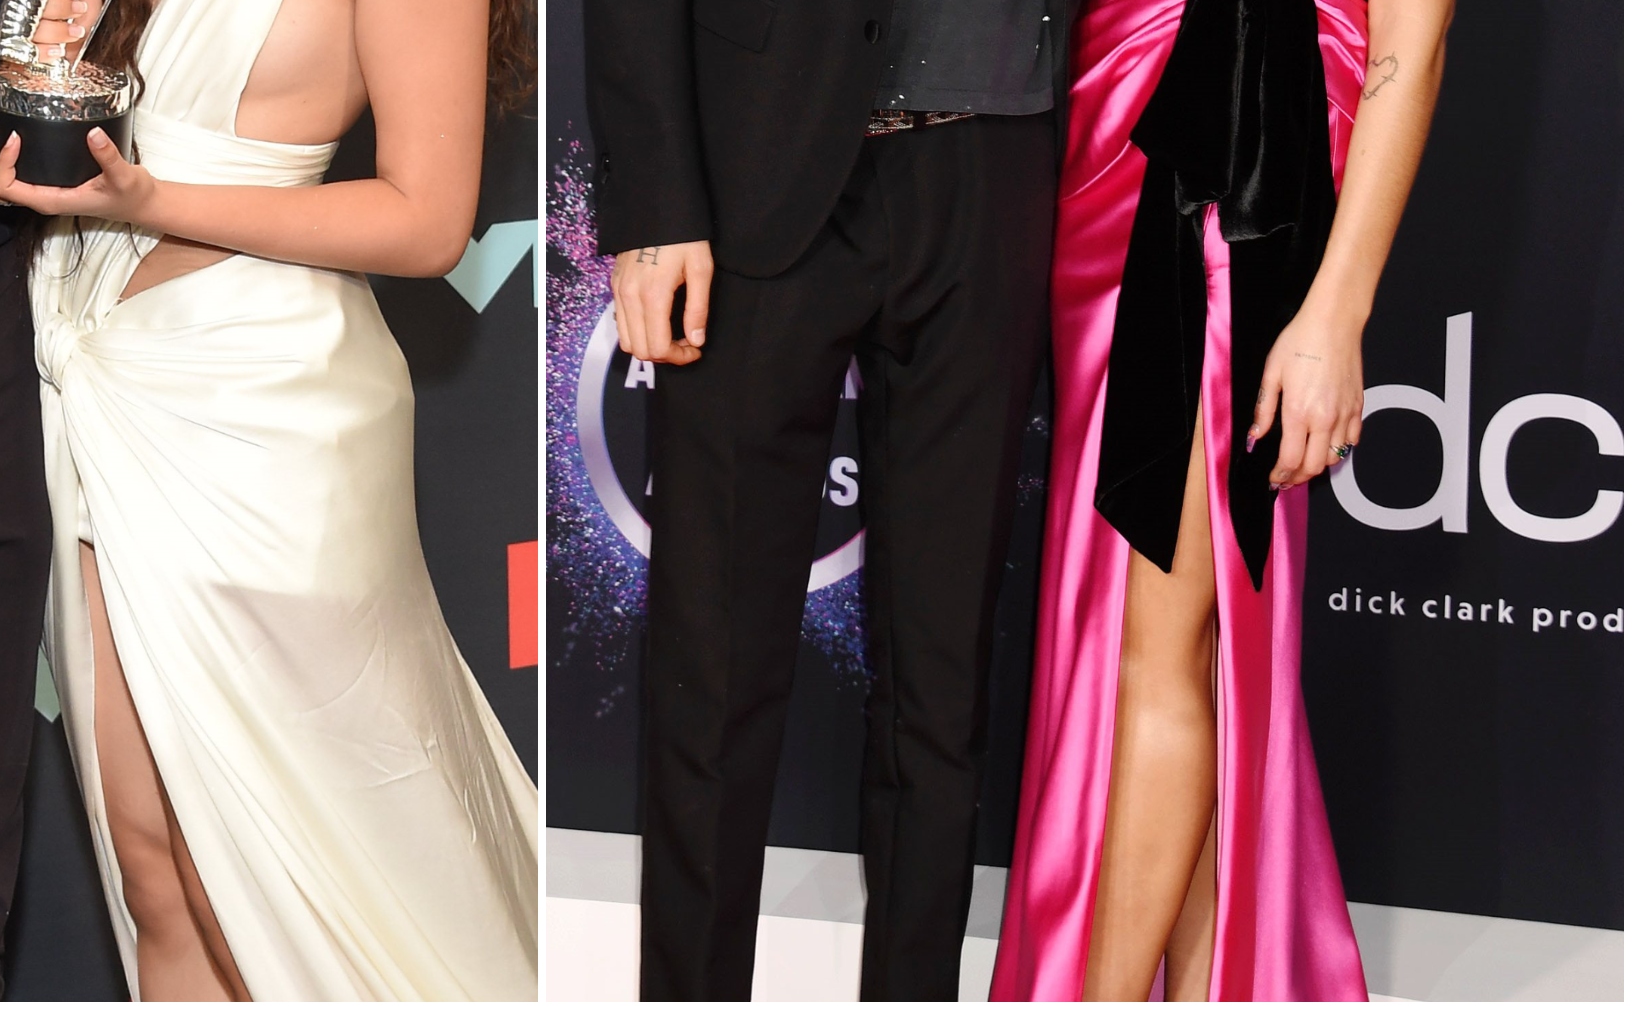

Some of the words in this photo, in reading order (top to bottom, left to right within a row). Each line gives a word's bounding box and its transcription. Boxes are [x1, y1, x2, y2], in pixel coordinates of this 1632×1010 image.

[1328, 587, 1406, 616] dick
[1421, 594, 1515, 625] clark
[1531, 606, 1624, 633] prod
